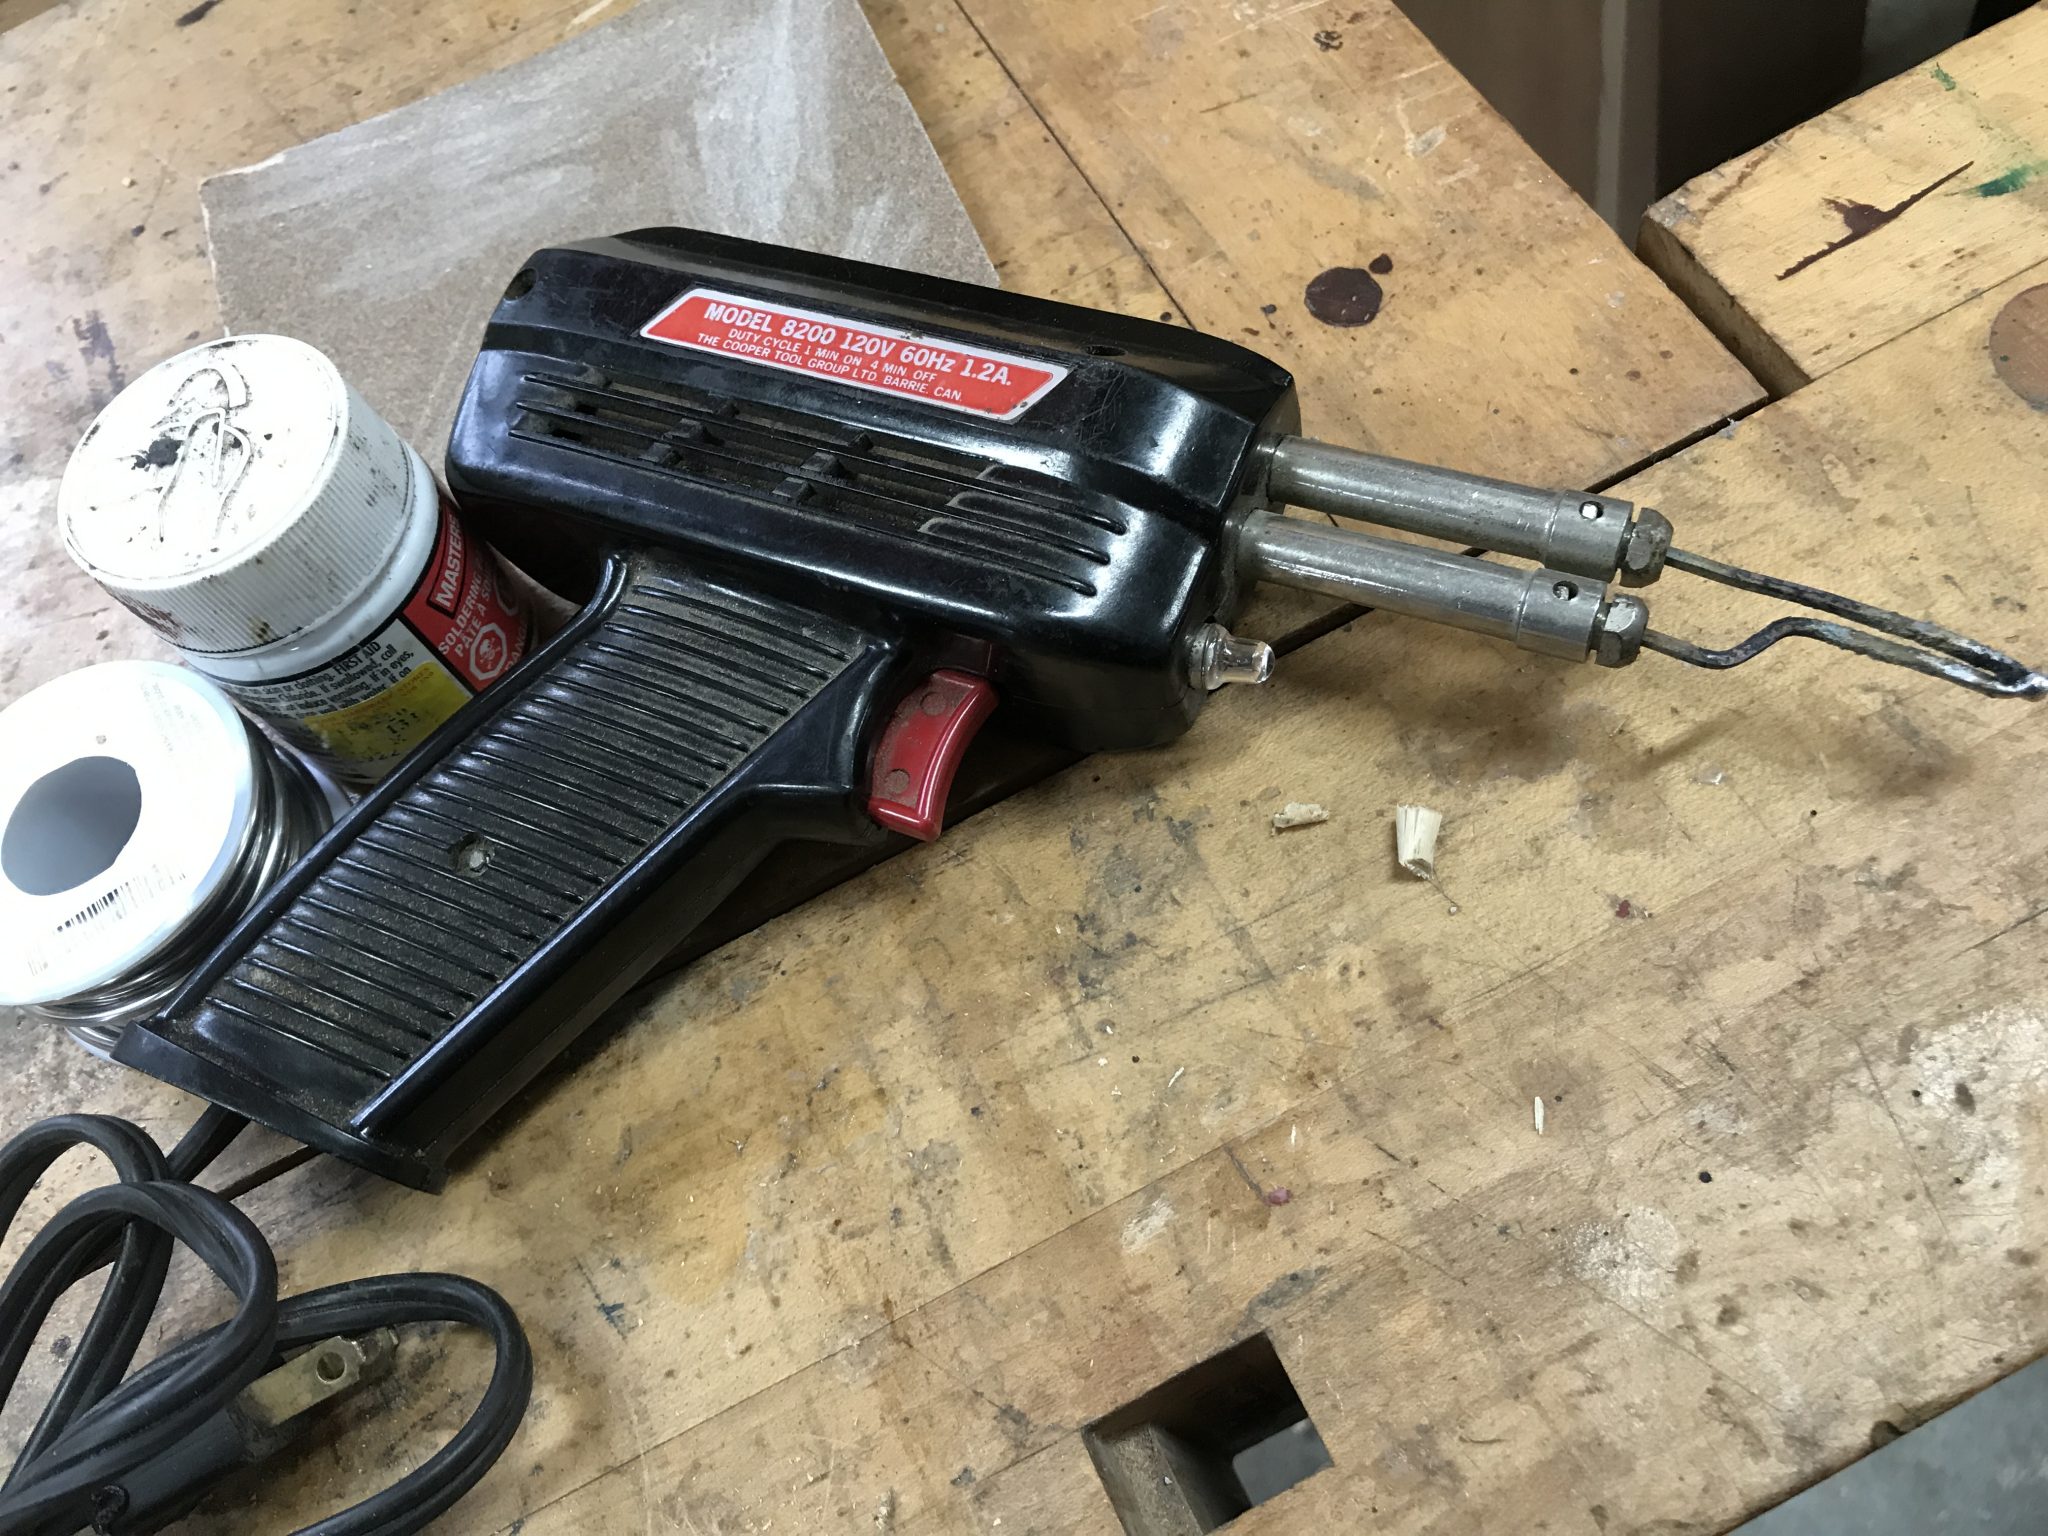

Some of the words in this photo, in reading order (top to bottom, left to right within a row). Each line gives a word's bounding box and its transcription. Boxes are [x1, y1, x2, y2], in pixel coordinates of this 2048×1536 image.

[697, 332, 721, 347] THE
[722, 339, 771, 358] COOPER
[774, 350, 803, 366] TOOL
[807, 358, 850, 375] GROUP
[704, 303, 772, 332] MODEL
[781, 319, 836, 345] 8200
[839, 331, 897, 358] 120V
[900, 345, 957, 373] 60Hz
[728, 328, 761, 343] DUTY
[763, 335, 802, 353] CYCLE
[804, 345, 811, 355] 1
[843, 354, 863, 367] ON
[870, 360, 879, 370] 4
[913, 370, 938, 383] OFF
[438, 570, 482, 655] SOLDERING
[333, 651, 364, 675] FIRST
[364, 641, 382, 659] AID
[380, 643, 398, 661] call
